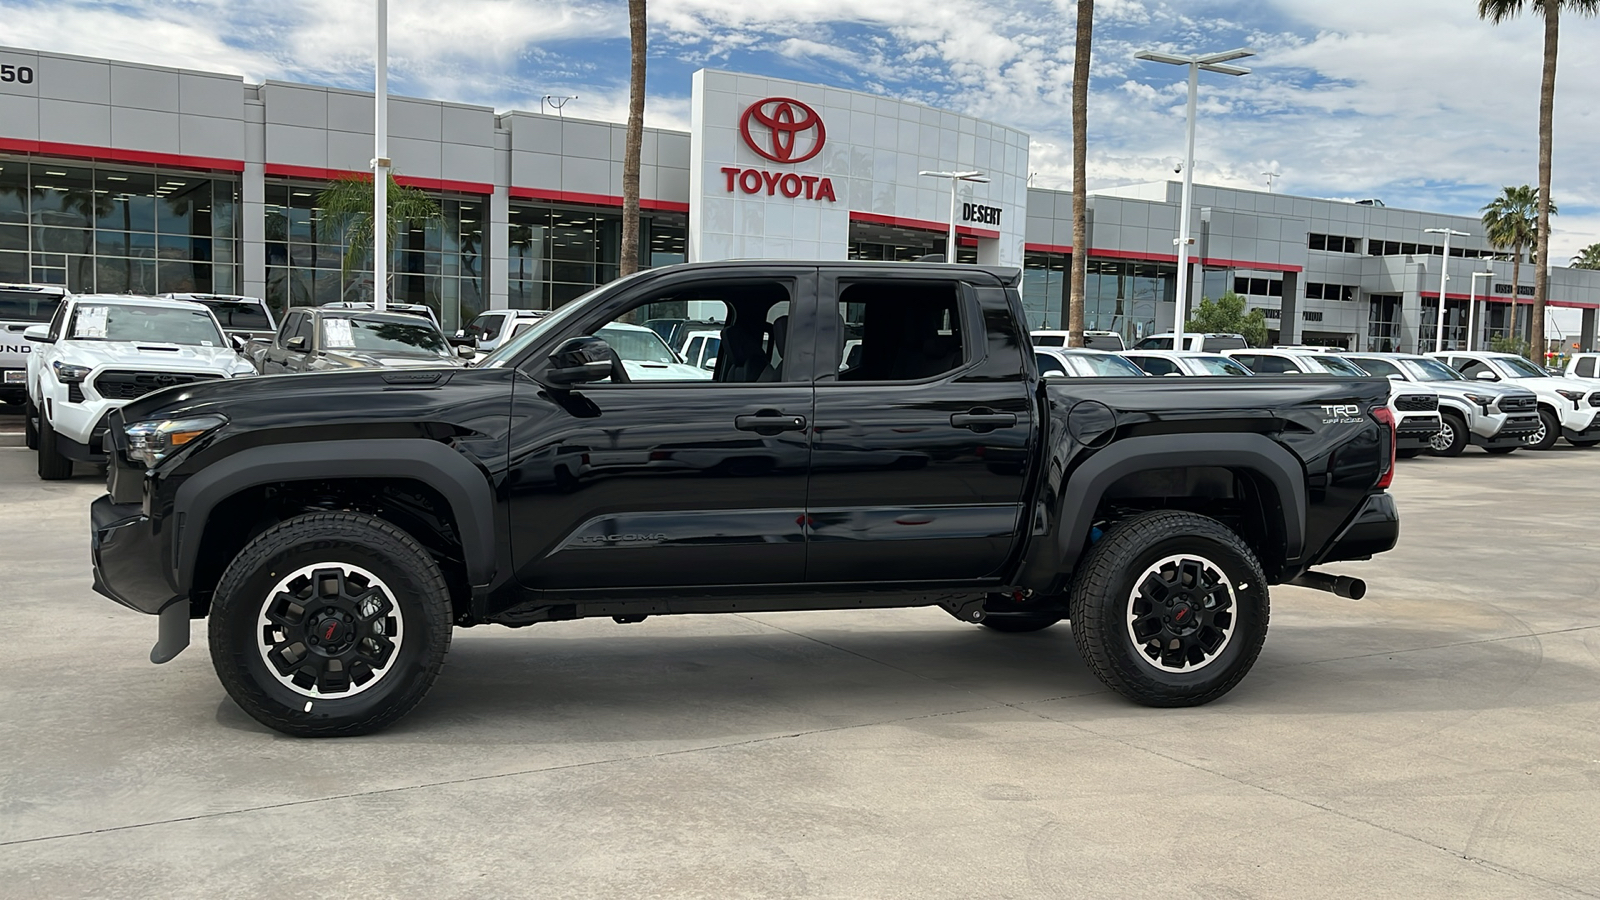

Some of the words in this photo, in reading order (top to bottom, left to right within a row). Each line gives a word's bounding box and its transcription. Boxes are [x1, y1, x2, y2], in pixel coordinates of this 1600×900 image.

[721, 167, 836, 202] TOYOTA
[963, 202, 1002, 225] DESERT
[1321, 404, 1360, 418] TRD
[577, 532, 668, 543] TACOMA
